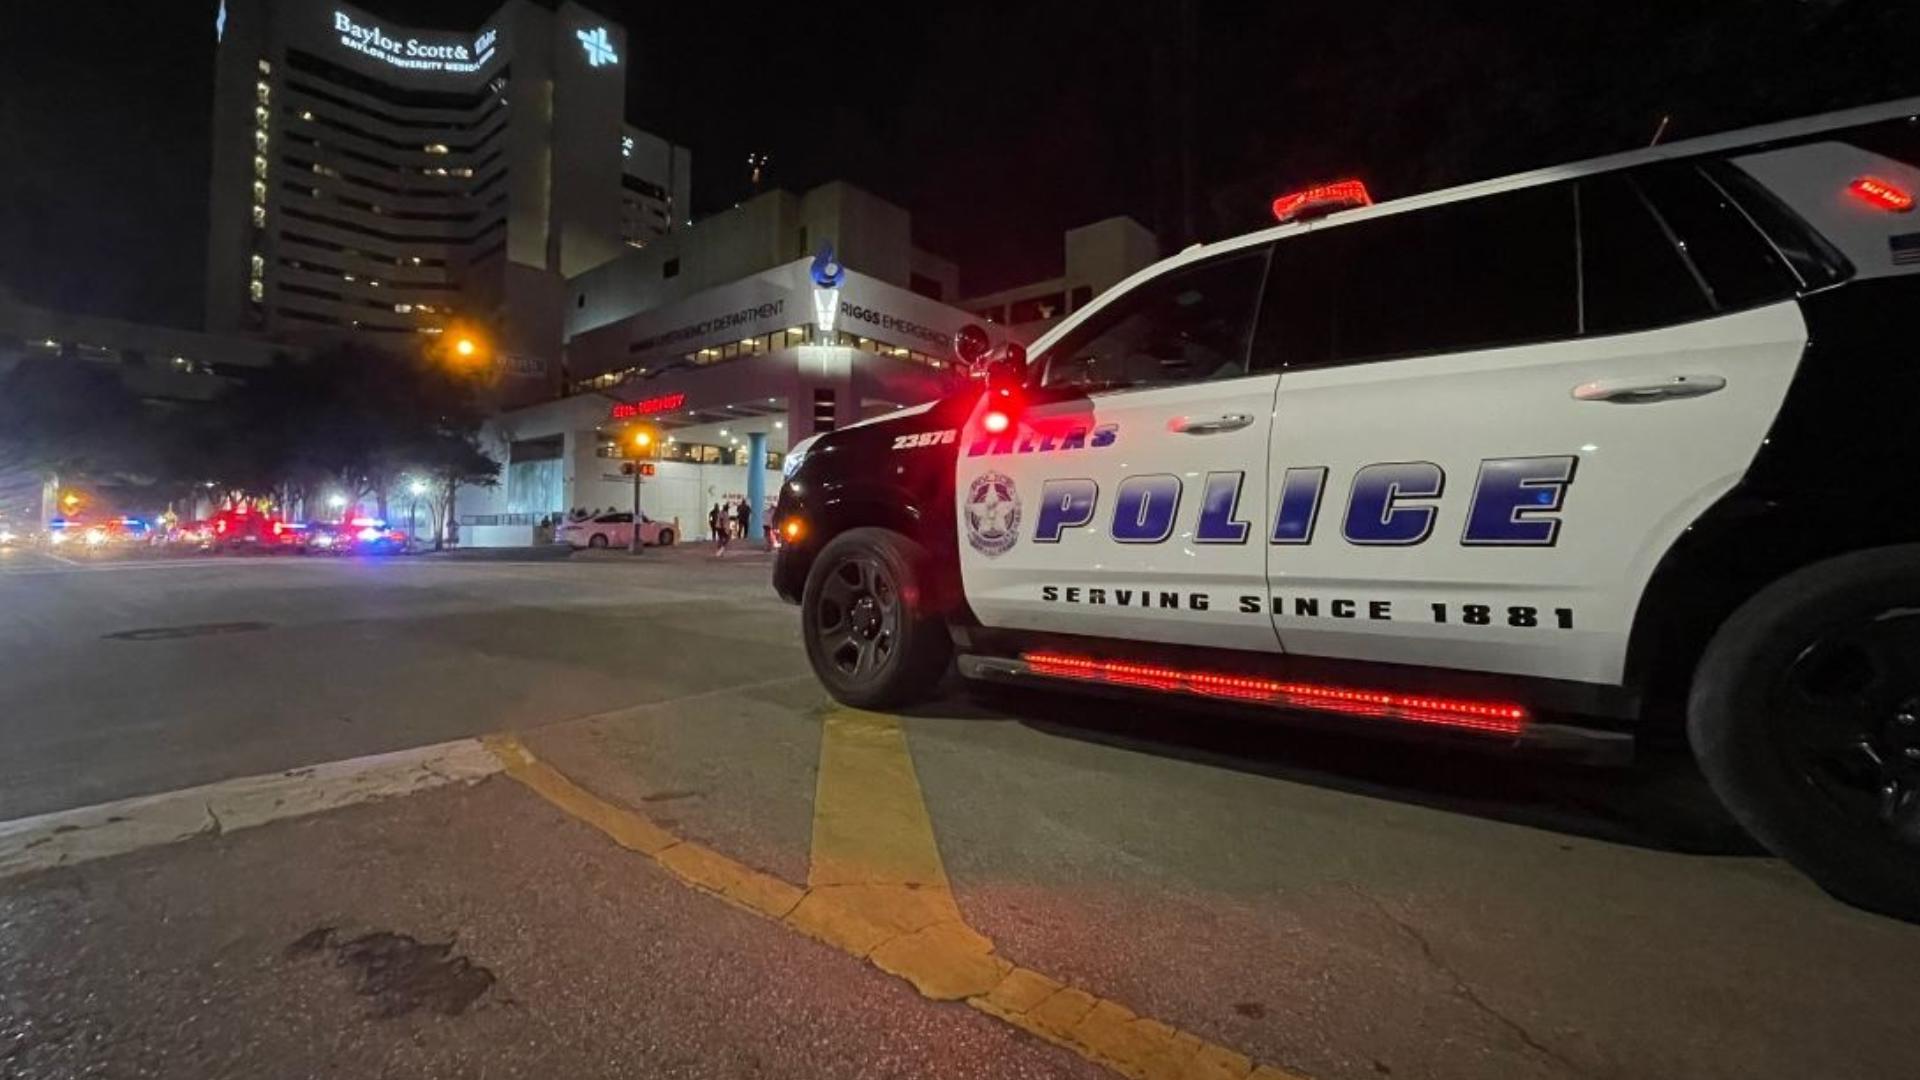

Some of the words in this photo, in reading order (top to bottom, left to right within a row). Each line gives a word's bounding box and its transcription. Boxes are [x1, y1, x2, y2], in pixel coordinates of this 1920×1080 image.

[334, 11, 403, 54] Baylor
[341, 36, 385, 60] BAYLOR
[387, 54, 442, 71] UNIVERSITY
[713, 299, 785, 333] DEPARTMENT
[841, 301, 881, 326] RIGGS
[1032, 454, 1580, 547] POLICE
[1042, 586, 1210, 612] SERVING
[1239, 595, 1393, 620] SINCE
[1431, 602, 1574, 629] 1881
